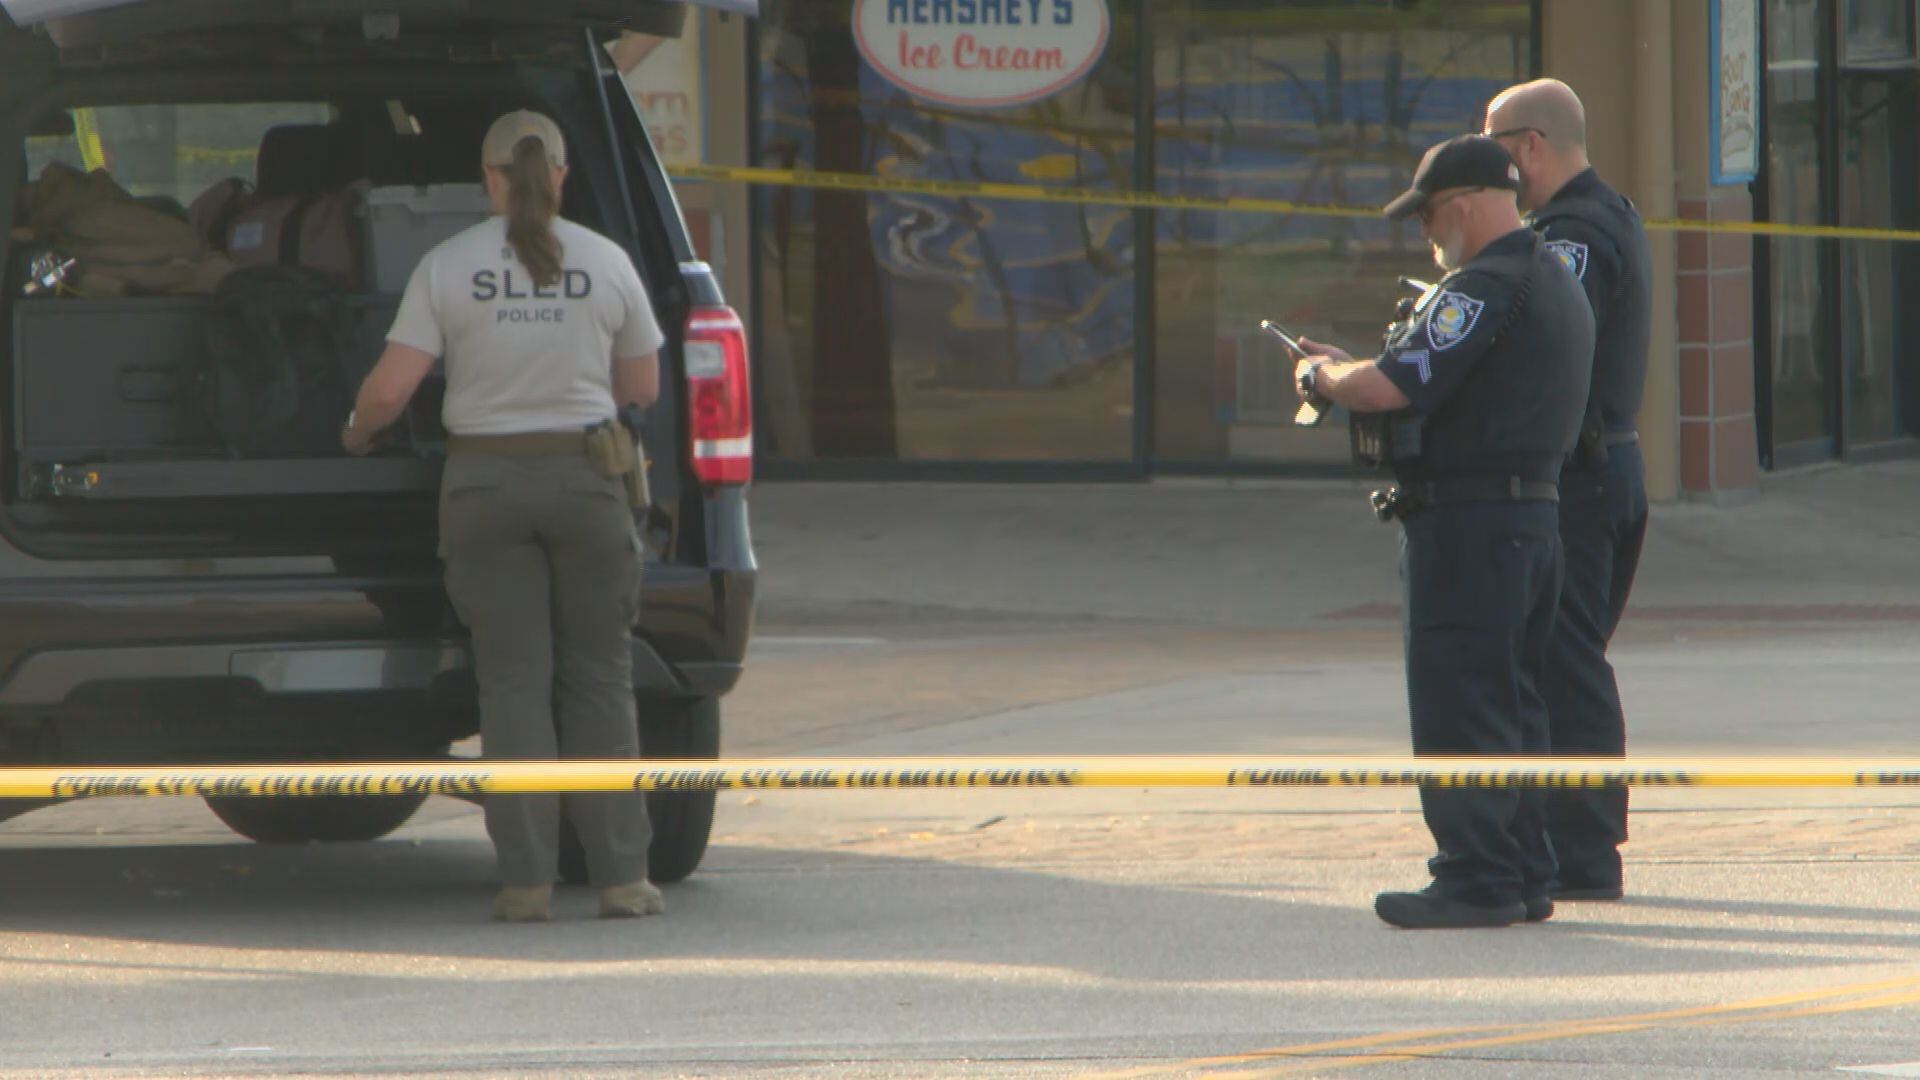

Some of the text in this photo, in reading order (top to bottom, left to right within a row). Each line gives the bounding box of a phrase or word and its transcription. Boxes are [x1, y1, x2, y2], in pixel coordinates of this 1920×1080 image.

[887, 0, 1073, 25] HERSHEYS
[898, 30, 1065, 71] Ice Cream
[497, 308, 564, 323] POLICE
